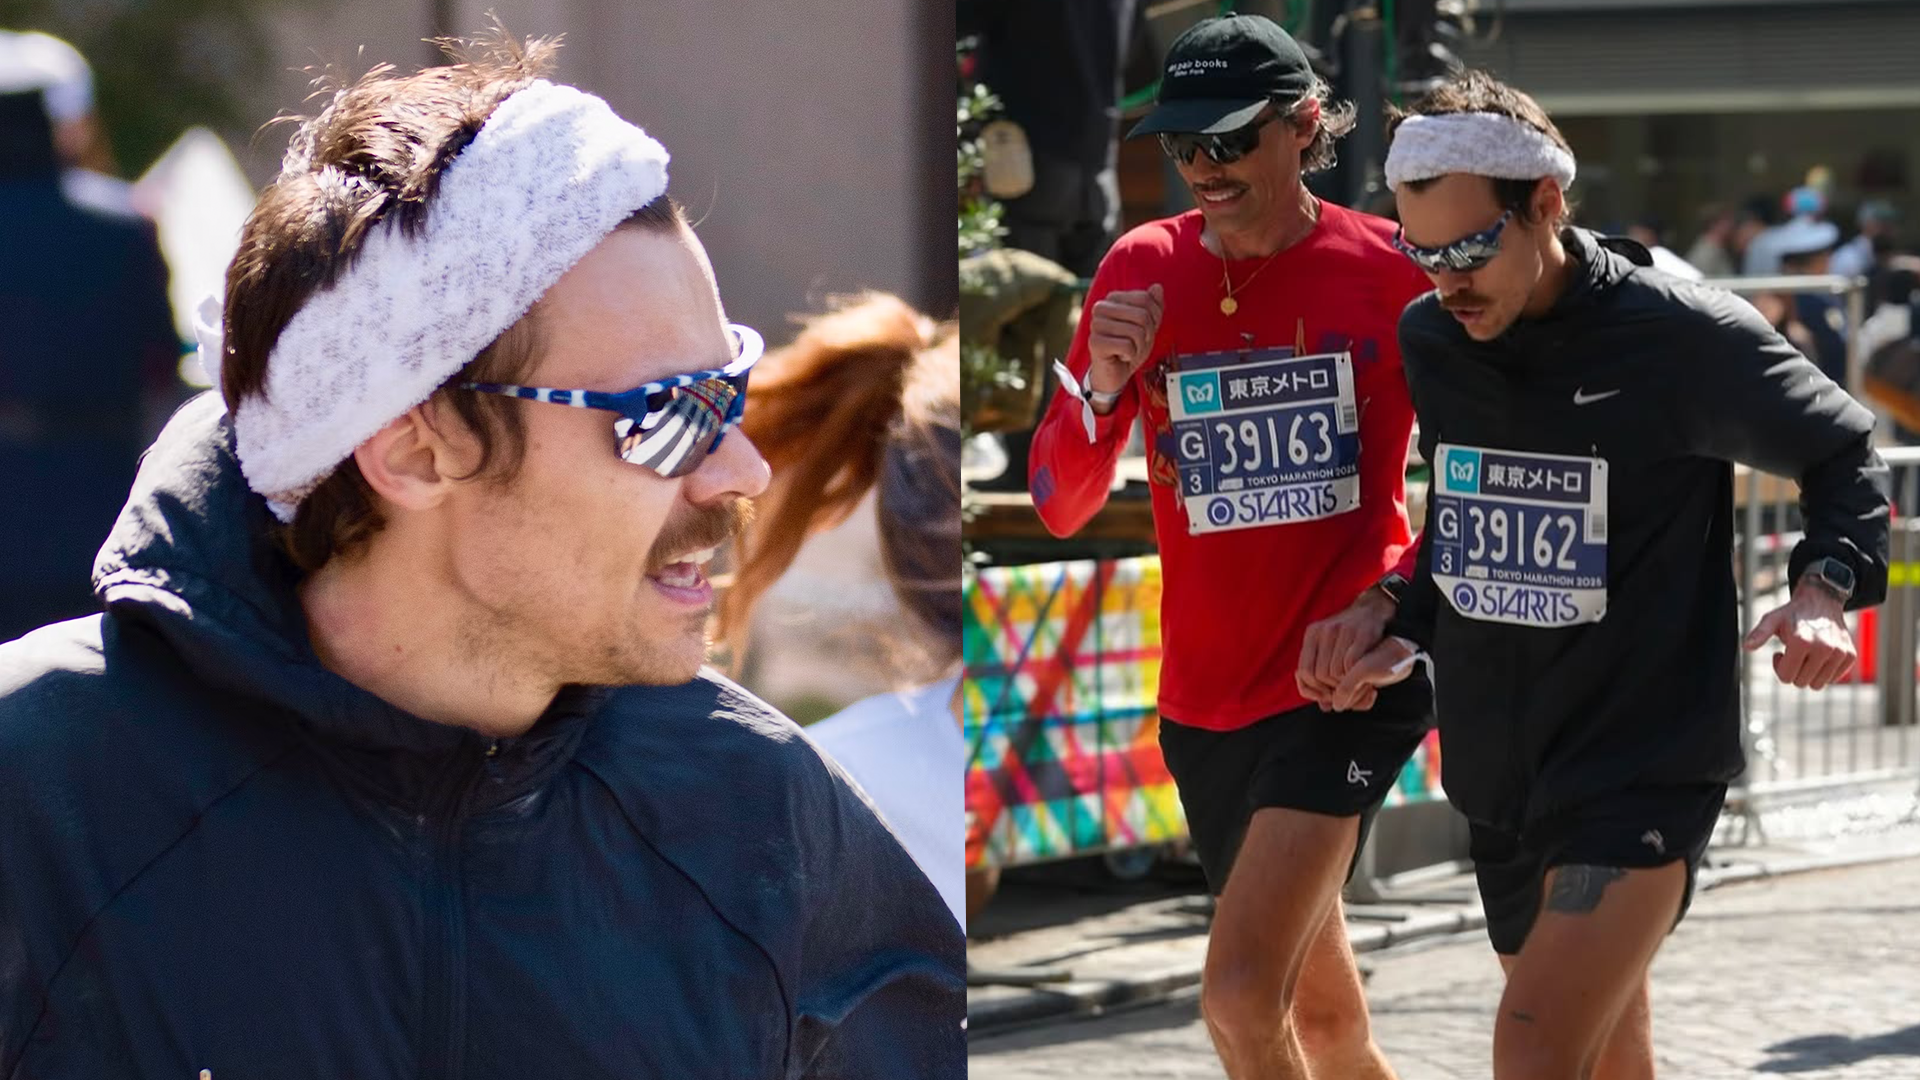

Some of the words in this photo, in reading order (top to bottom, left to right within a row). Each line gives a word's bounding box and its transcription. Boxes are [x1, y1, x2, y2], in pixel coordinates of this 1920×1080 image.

[1194, 58, 1228, 68] books
[1228, 369, 1329, 400] 東京メトロ
[1180, 431, 1205, 460] G
[1215, 411, 1333, 474] 39163
[1189, 474, 1203, 493] 3
[1247, 474, 1278, 487] TOKYO
[1279, 468, 1334, 484] MARATHON
[1487, 464, 1582, 493] 東京メトロ
[1438, 507, 1459, 539] G
[1467, 506, 1577, 571] 39162
[1440, 552, 1453, 573] 3
[1492, 568, 1522, 581] TOKYO
[1523, 571, 1574, 587] MARATHON
[1575, 577, 1603, 588] 2025
